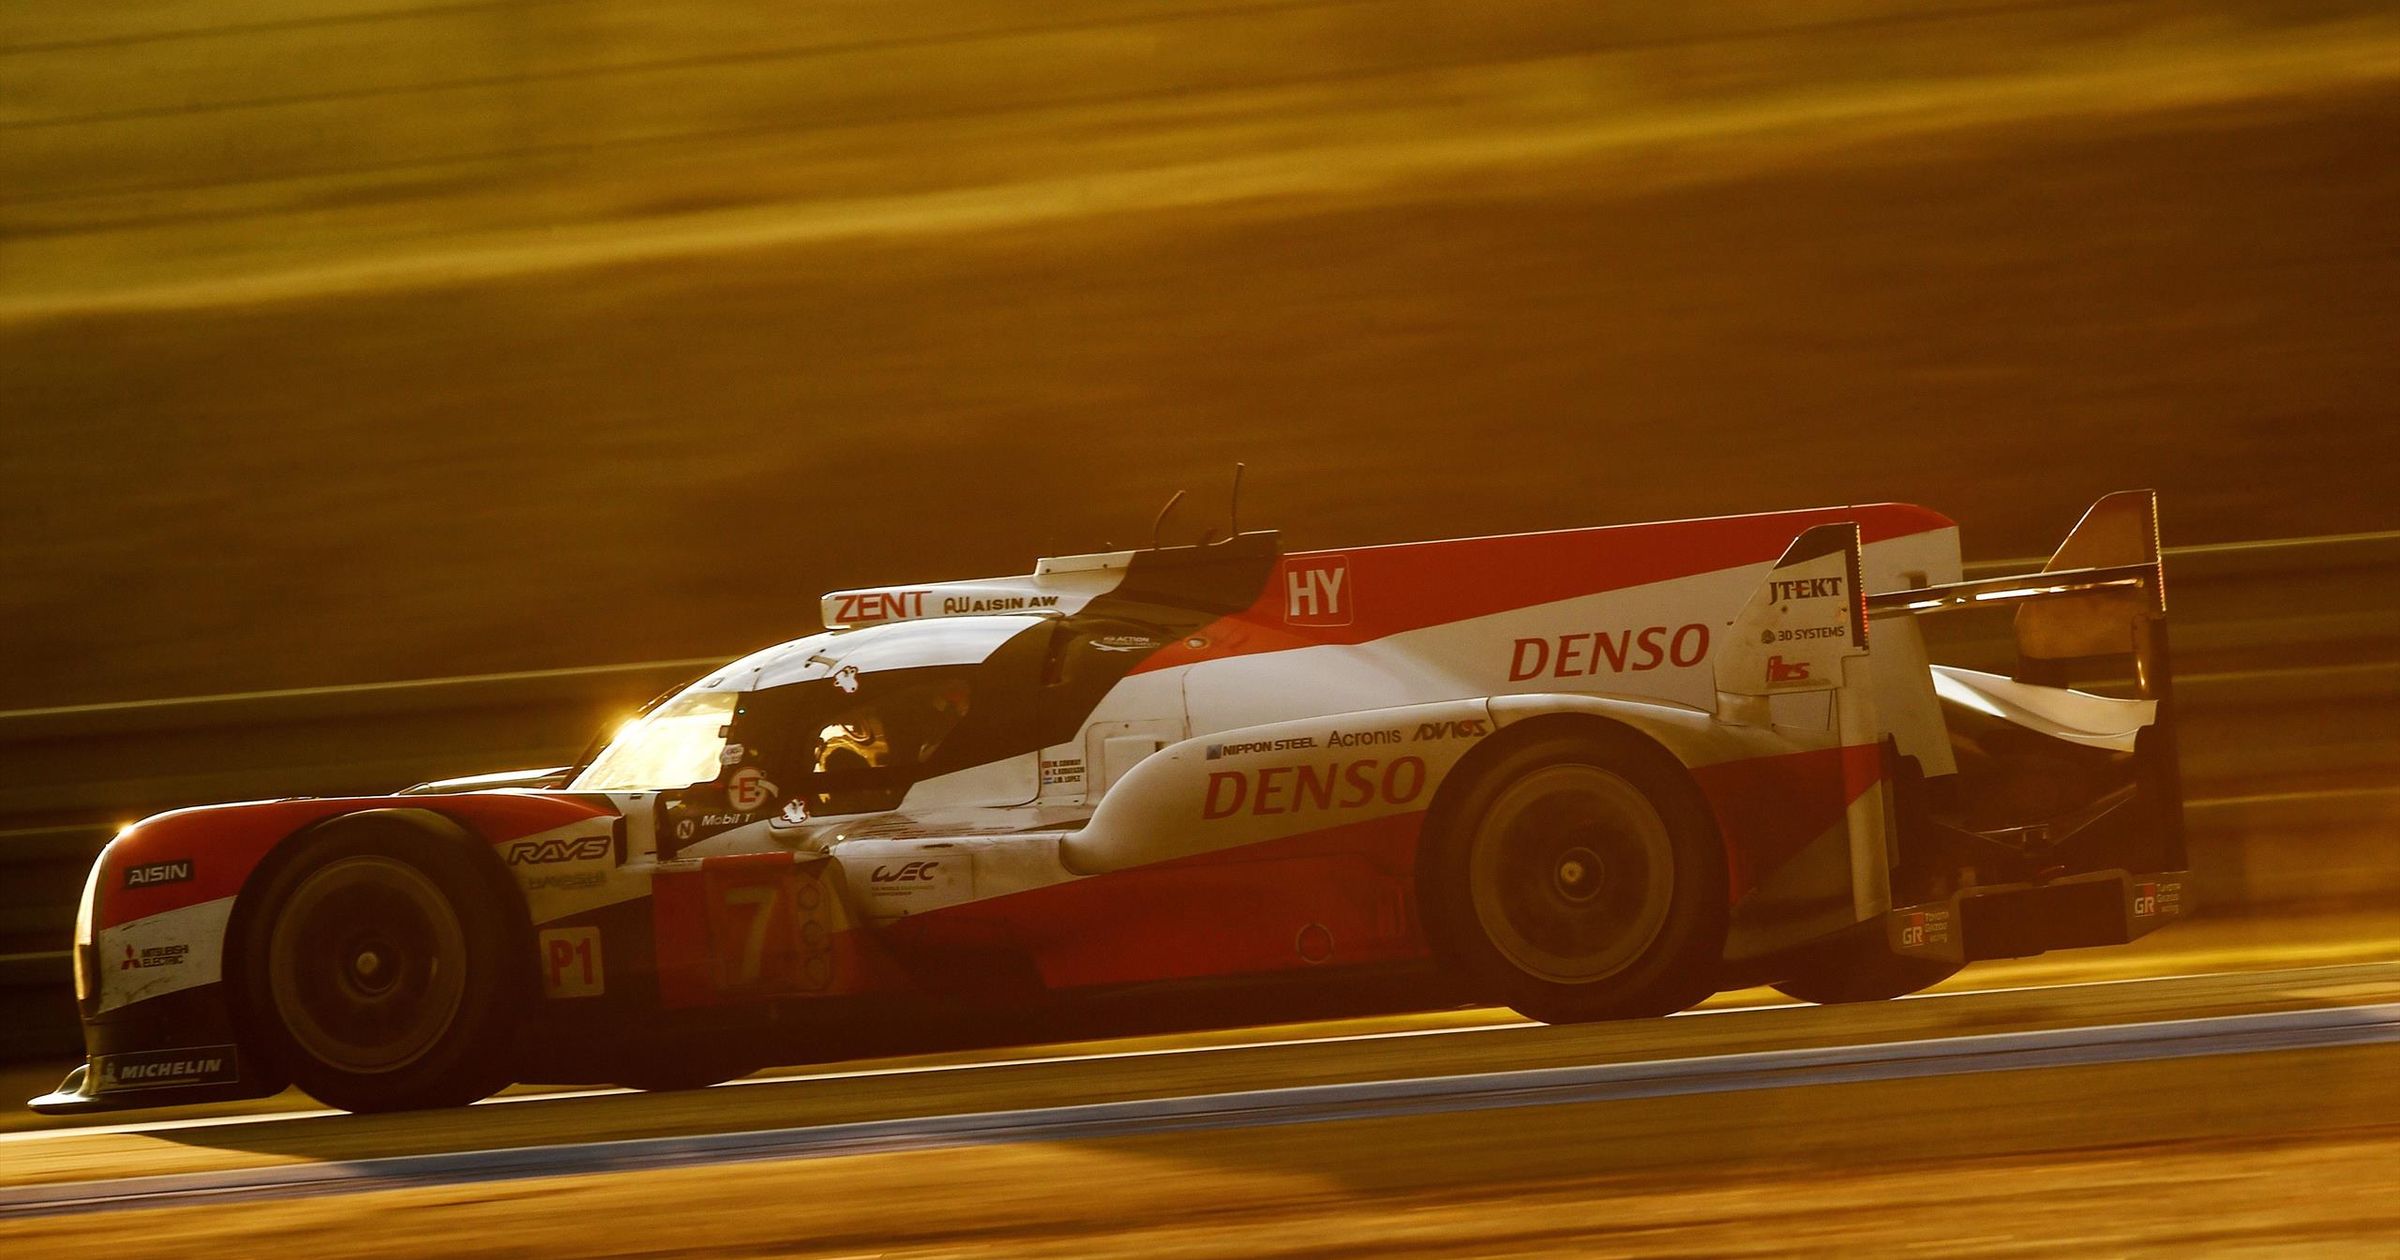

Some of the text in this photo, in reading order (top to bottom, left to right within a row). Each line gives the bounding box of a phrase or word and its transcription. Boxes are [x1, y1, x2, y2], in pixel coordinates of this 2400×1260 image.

[1288, 567, 1345, 616] HY
[1768, 576, 1843, 606] JTEKT
[835, 590, 933, 624] ZENT
[973, 598, 1023, 612] AISIN
[1029, 596, 1059, 608] AW
[1778, 626, 1846, 642] 3D SYSTEMS
[1508, 623, 1710, 682] DENSO
[1222, 737, 1318, 756] NIPPON STEEL
[1327, 729, 1402, 749] Acronis
[738, 777, 759, 804] E
[1202, 756, 1426, 820] DENSO
[701, 813, 740, 827] Mobil
[507, 835, 612, 866] RAYS
[128, 863, 188, 886] AISIN
[871, 861, 940, 883] WEC
[2134, 896, 2155, 915] GR
[723, 886, 779, 979] 7
[1902, 926, 1924, 945] GR
[141, 945, 189, 958] MITSUBISHI
[143, 955, 184, 967] ELECTRIC
[550, 937, 594, 988] P1
[121, 1058, 222, 1080] MICHELIN
